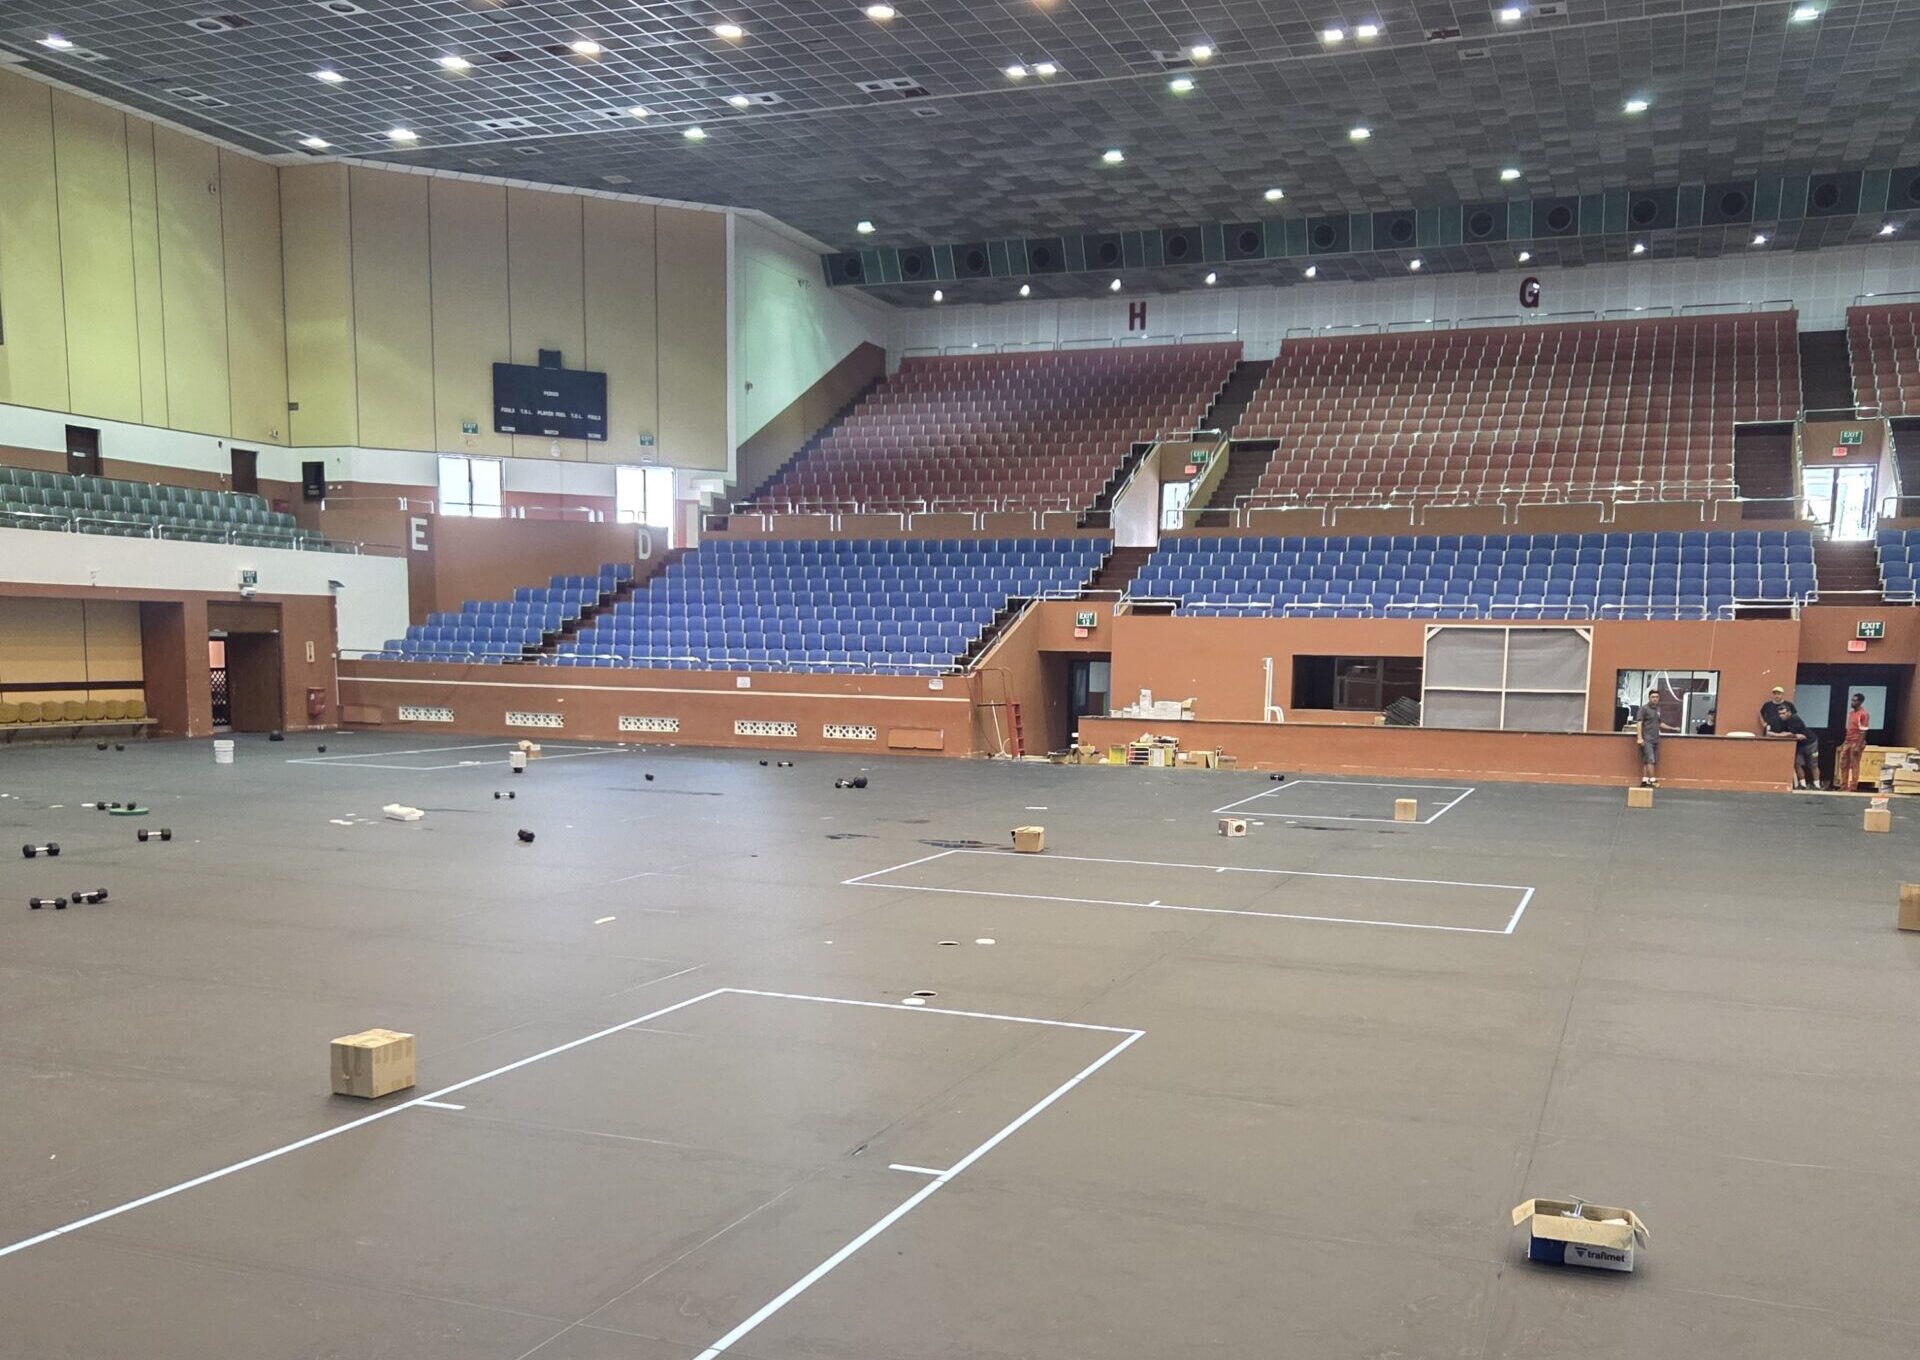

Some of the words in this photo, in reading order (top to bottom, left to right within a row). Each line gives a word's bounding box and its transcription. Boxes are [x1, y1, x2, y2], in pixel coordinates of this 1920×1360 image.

[1519, 276, 1540, 309] G
[1129, 301, 1146, 331] H
[411, 516, 429, 552] E
[638, 528, 652, 560] D
[1587, 1250, 1625, 1263] trafimet
